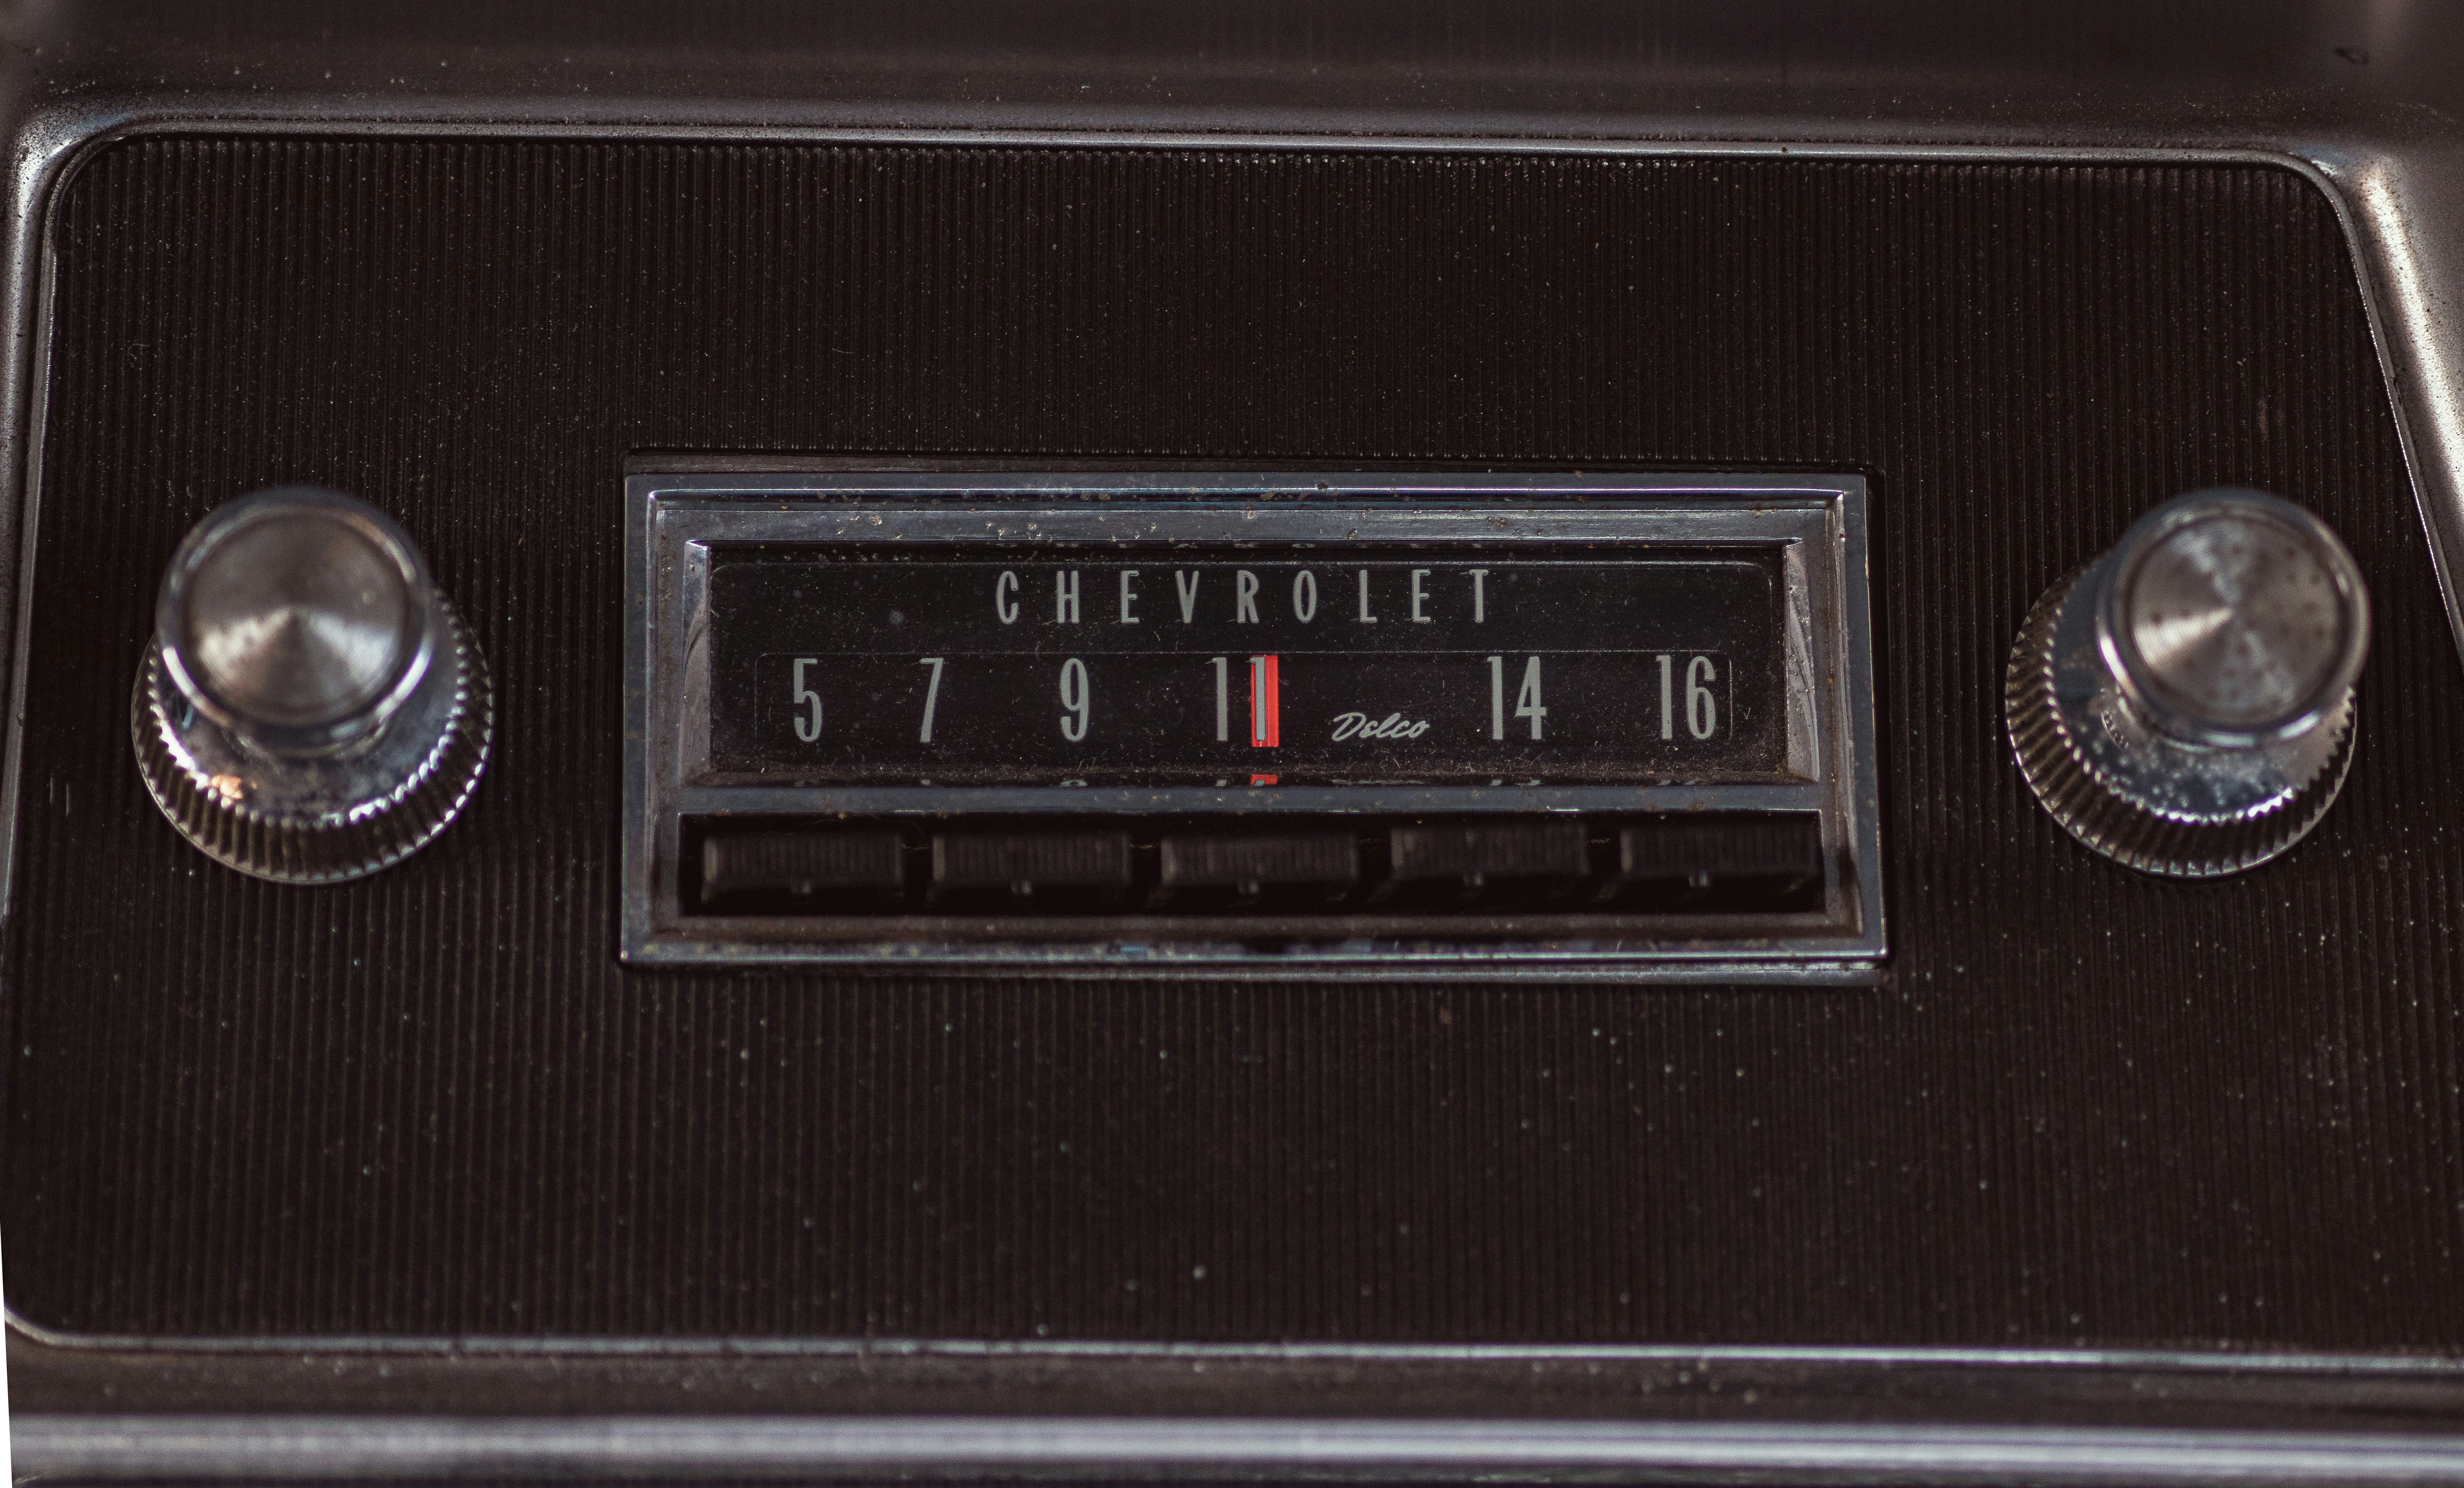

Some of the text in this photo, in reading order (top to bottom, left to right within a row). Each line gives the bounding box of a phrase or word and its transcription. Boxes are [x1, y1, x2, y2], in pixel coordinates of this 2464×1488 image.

[997, 569, 1489, 625] CHEVROLET
[794, 655, 1717, 743] 5 7 9 11 14 16
[1332, 712, 1430, 742] Delco
